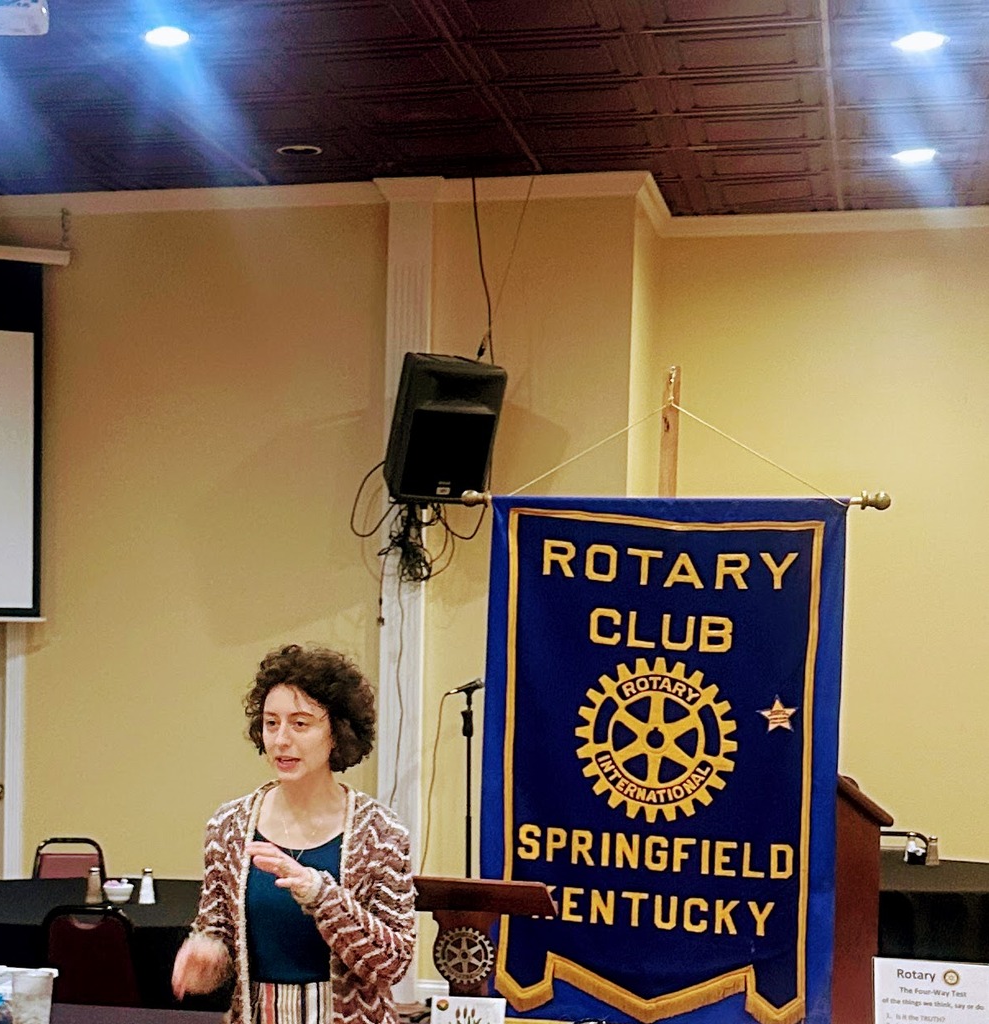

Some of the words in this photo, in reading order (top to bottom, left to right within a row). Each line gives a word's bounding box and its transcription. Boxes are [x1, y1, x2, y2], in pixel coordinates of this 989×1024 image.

[542, 539, 799, 590] ROTARY
[589, 608, 734, 653] CLUB
[622, 676, 700, 702] ROTARY
[597, 754, 711, 803] INTERNATIONAL
[517, 823, 794, 880] SPRINGFIELD
[897, 969, 936, 982] Rotary
[914, 988, 949, 997] Four-Way
